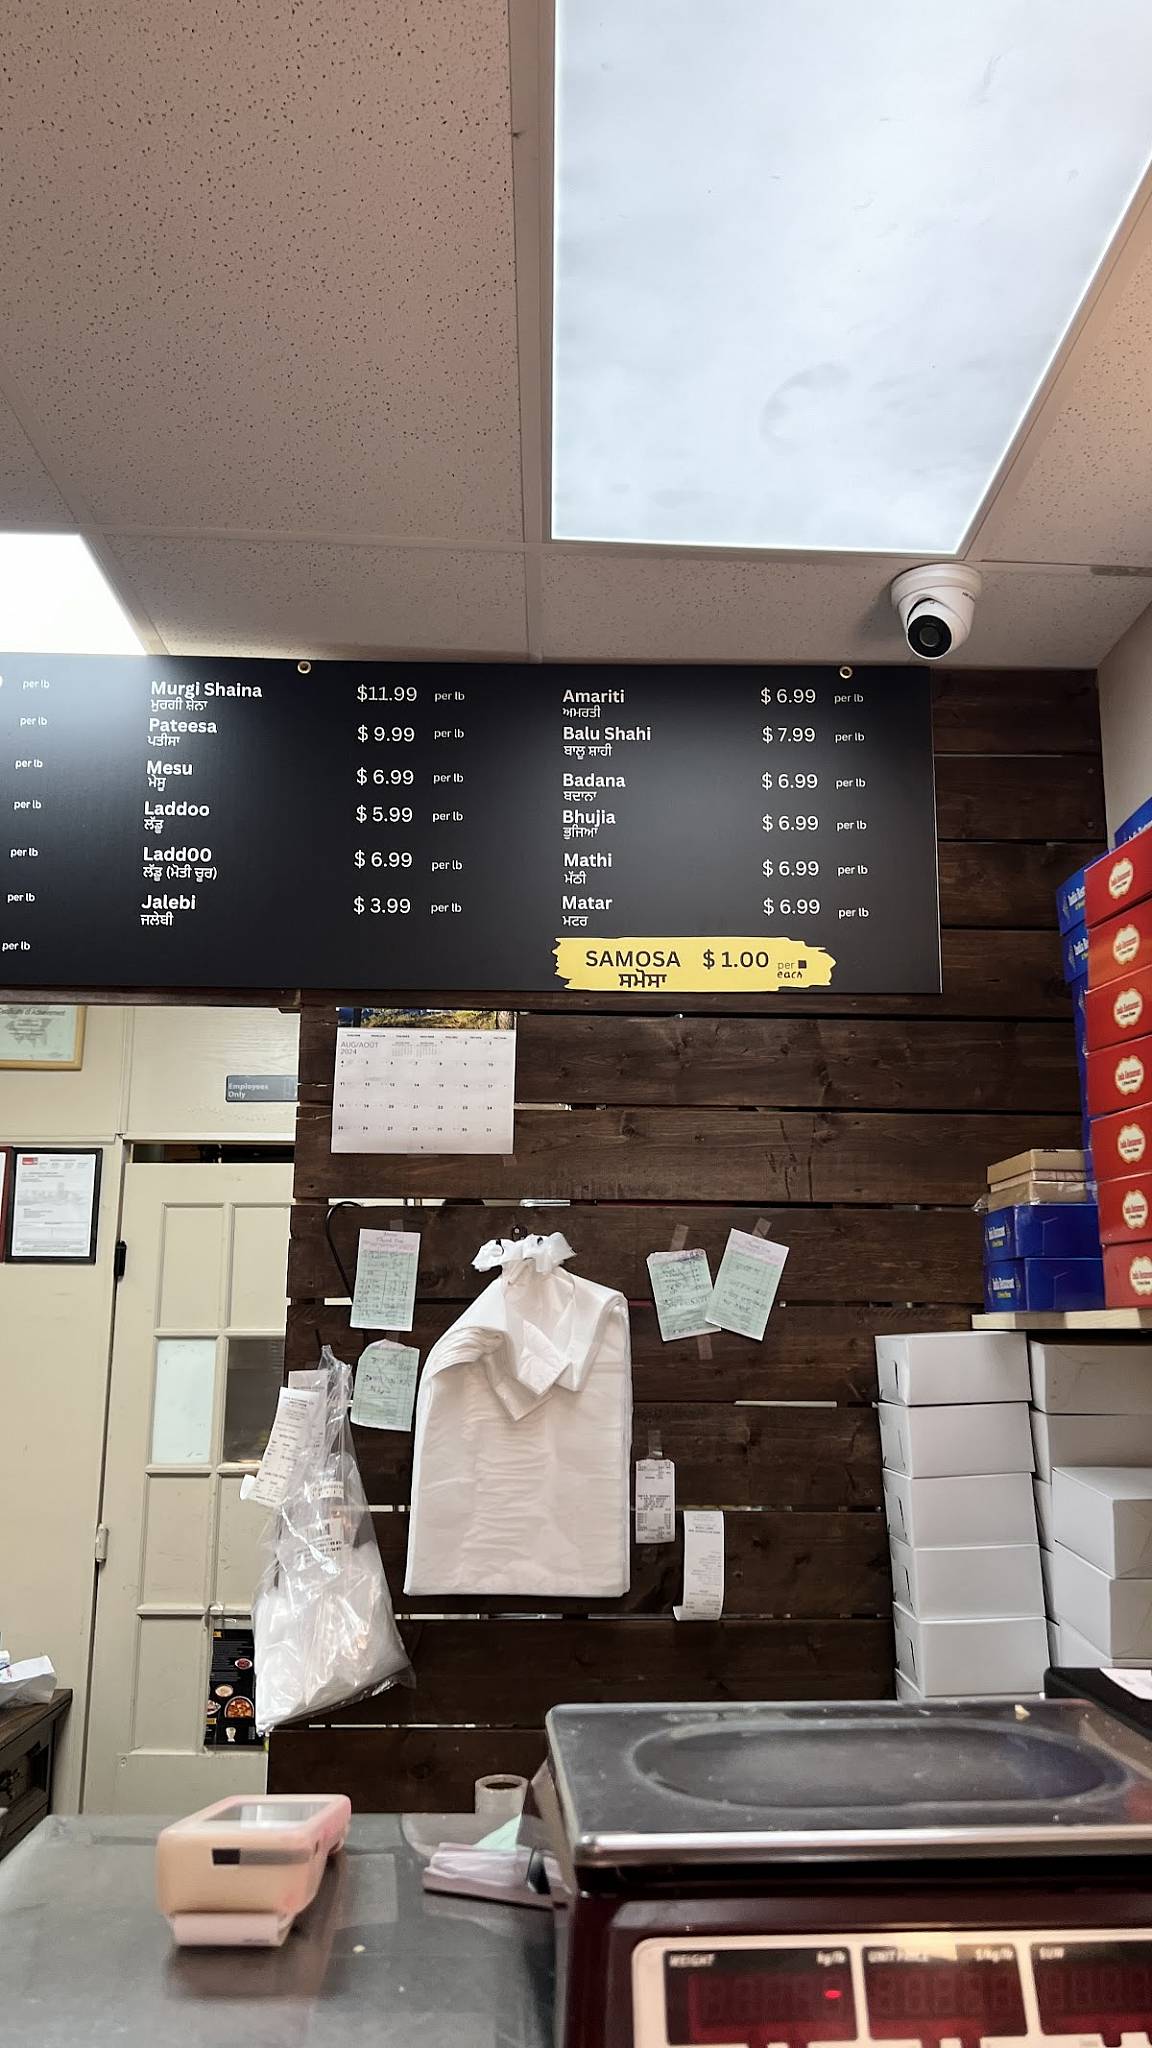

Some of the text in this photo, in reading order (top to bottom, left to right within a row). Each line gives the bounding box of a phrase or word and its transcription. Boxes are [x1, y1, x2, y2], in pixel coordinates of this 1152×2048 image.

[22, 680, 50, 690] per lb
[151, 681, 263, 699] Murgi Shaina
[357, 684, 466, 703] $11.99 per lb
[563, 689, 625, 703] Amariti
[776, 689, 816, 704] 6.99
[834, 694, 852, 705] per
[854, 693, 864, 703] lb
[562, 705, 601, 718] ਅਮਰਤੀ
[20, 717, 48, 727] per lb
[149, 718, 218, 733] Pateesa
[147, 733, 180, 746] ਪਤੀਸਾ
[373, 727, 416, 743] 9.99
[433, 730, 452, 741] per
[454, 729, 465, 739] lb
[563, 726, 651, 741] Balu Shahi
[777, 728, 816, 743] 7.99
[834, 732, 853, 743] per
[854, 731, 865, 741] lb
[563, 745, 586, 760] ਬਾਲੂ
[15, 759, 44, 770] per lb
[146, 760, 194, 776] Mesu
[372, 769, 415, 786] 6.99
[433, 773, 452, 784] per
[453, 772, 464, 782] lb
[562, 773, 626, 788] Badana
[778, 774, 818, 789] 6.99
[835, 778, 854, 789] per
[855, 777, 866, 787] lb
[563, 791, 598, 802] ਬਦਾਨਾ
[13, 799, 42, 811] per lb
[144, 801, 210, 817] Laddoo
[371, 807, 413, 823] 5.99
[432, 811, 451, 823] per
[452, 810, 464, 821] lb
[562, 809, 617, 828] Bhujia
[778, 816, 819, 831] 6.99
[836, 820, 855, 832] per
[856, 819, 867, 830] lb
[10, 847, 39, 859] per lb
[563, 853, 612, 868] Mathi
[370, 852, 413, 868] 6.99
[431, 860, 451, 872] per
[452, 859, 463, 870] lb
[778, 861, 820, 877] 6.99
[837, 865, 856, 877] per
[857, 864, 869, 875] lb
[7, 892, 36, 904] per lb
[141, 894, 196, 910] Jalebi
[562, 896, 613, 910] Matar
[369, 898, 411, 914] 3.99
[430, 903, 450, 915] per
[451, 902, 462, 913] lb
[779, 899, 821, 915] 6.99
[838, 908, 857, 920] per
[858, 907, 870, 918] lb
[562, 915, 589, 927] ਮਟਰ
[1, 940, 31, 953] per lb
[585, 951, 681, 967] SAMOSA
[721, 951, 769, 968] 1.00
[777, 962, 795, 970] per
[618, 968, 667, 988] ਸਮੋਸਾ
[777, 971, 803, 979] each
[228, 1083, 269, 1091] Employees
[228, 1091, 246, 1099] Only
